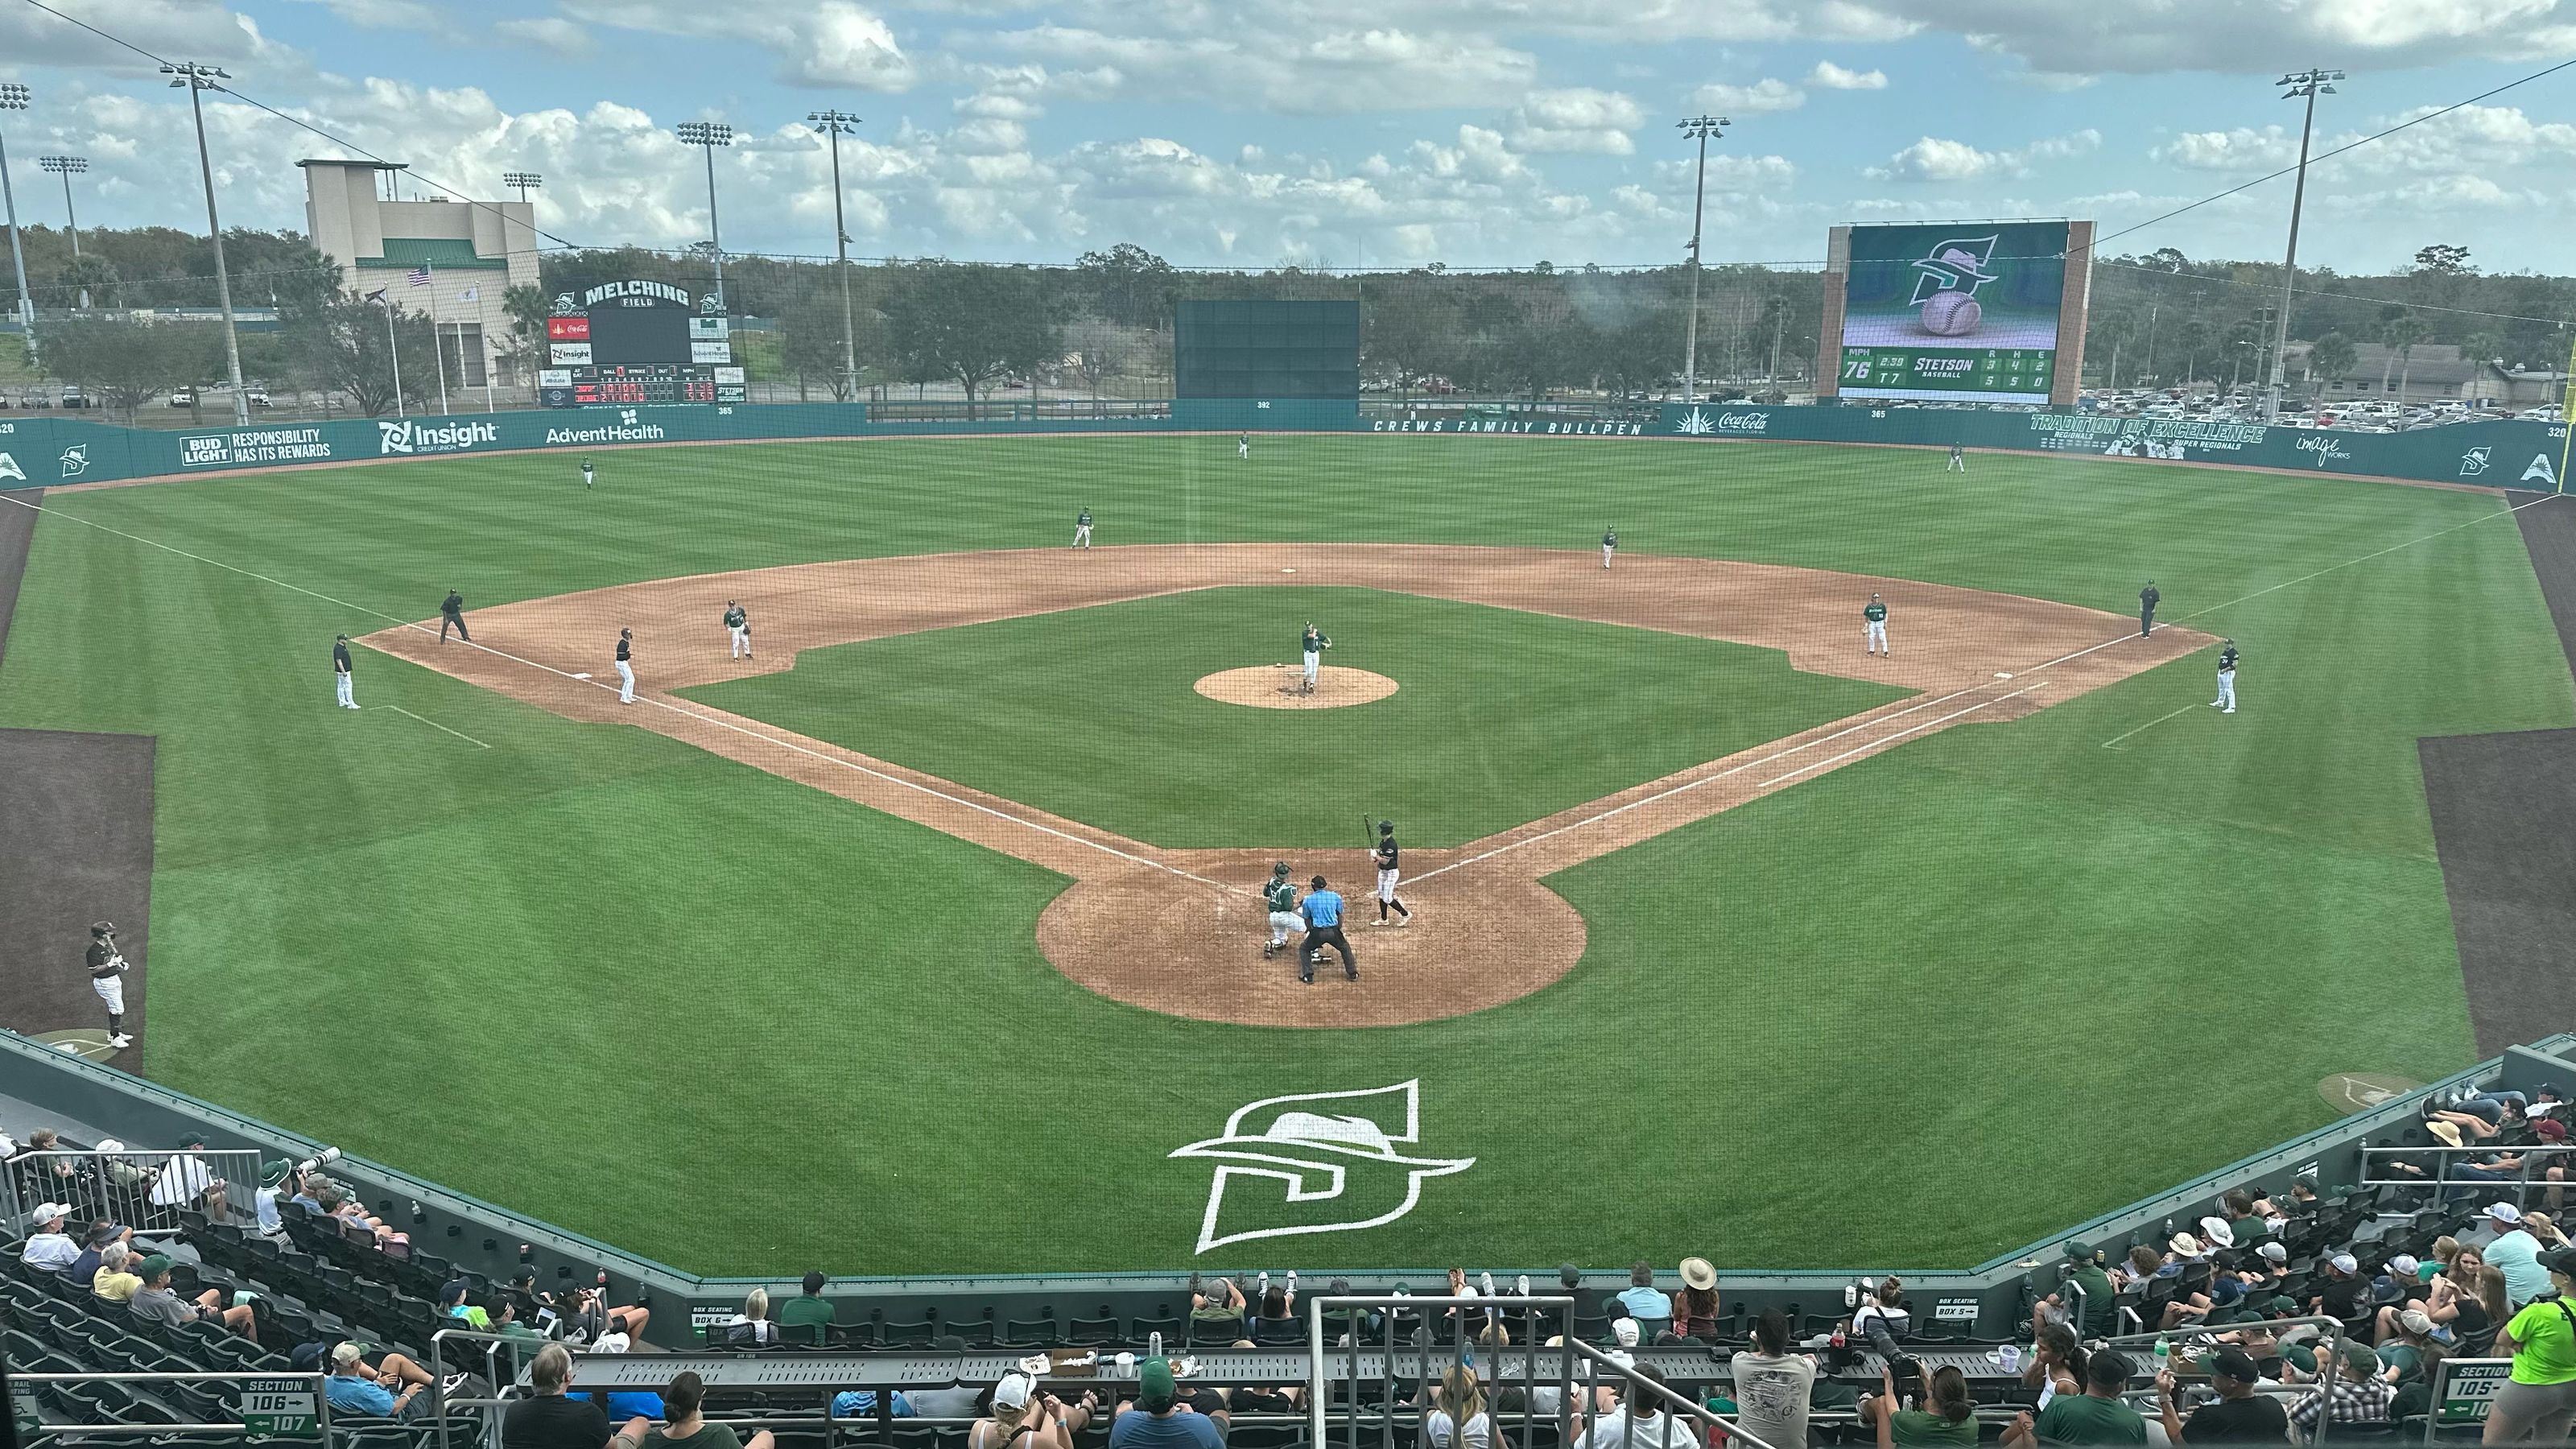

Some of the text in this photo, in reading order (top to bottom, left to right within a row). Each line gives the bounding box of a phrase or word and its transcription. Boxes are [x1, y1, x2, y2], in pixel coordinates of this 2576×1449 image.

[585, 280, 690, 307] MELCHING
[622, 298, 653, 307] FIELD
[564, 349, 589, 359] Insight
[1848, 348, 1870, 356] MPH
[1844, 361, 1872, 379] 76
[1880, 357, 2045, 371] 2:39 STETSON 3 4 2
[1880, 373, 1899, 384] T 7
[1985, 376, 2043, 386] 5 5 0
[718, 407, 733, 415] 365
[1257, 401, 1270, 409] 392
[1718, 411, 1771, 430] Coca-Cola
[1871, 410, 1886, 419] 365
[0, 423, 14, 434] 20
[415, 421, 497, 448] Insight
[546, 423, 664, 443] AdventHealth
[1373, 420, 1642, 436] CREWS FAMILY BULLPEN
[2030, 414, 2267, 444] TRADITION OF EXCELLENCE
[2547, 427, 2566, 438] 320
[232, 428, 320, 448] RESPONSIBILITY
[2054, 431, 2094, 440] REGIONALS
[189, 438, 221, 452] BUD
[2174, 439, 2198, 448] SUPER
[2199, 441, 2242, 451] REGIONALS
[2296, 432, 2339, 467] image
[184, 448, 229, 463] LIGHT
[234, 443, 331, 463] HAS ITS REWARDS
[2326, 451, 2351, 459] WORKS
[2459, 1366, 2512, 1377] SECTION
[249, 1381, 303, 1391] SECTION
[2457, 1381, 2493, 1396] 105
[252, 1395, 287, 1410] 106
[2469, 1401, 2492, 1417] 10
[273, 1416, 306, 1431] 107
